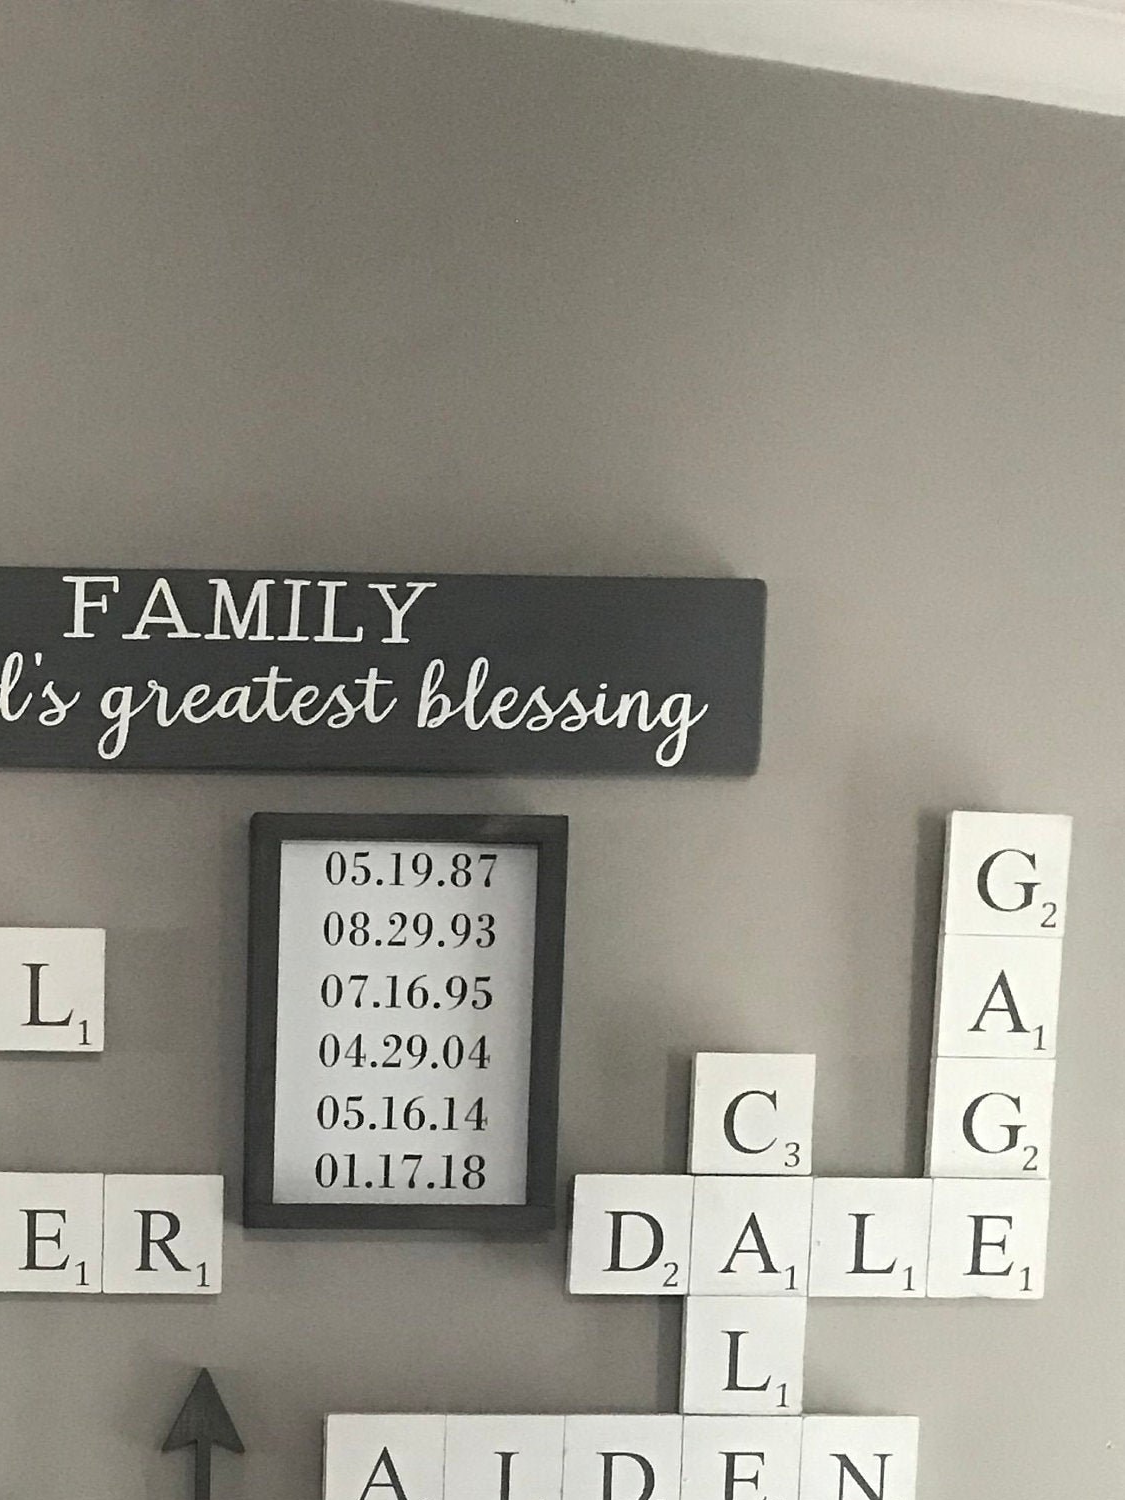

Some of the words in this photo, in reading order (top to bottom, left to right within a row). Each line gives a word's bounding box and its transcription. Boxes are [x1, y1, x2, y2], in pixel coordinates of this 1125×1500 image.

[62, 575, 437, 644] FAMILY
[98, 665, 397, 760] greatest
[417, 657, 708, 768] blessing
[325, 851, 498, 888] 05.19.87
[323, 911, 497, 949] 08.29.93
[1040, 901, 1057, 929] 2
[321, 973, 493, 1011] 07.16.95
[78, 1019, 92, 1046] 1
[1033, 1024, 1047, 1051] 1
[318, 1033, 491, 1069] 04.29.04
[962, 848, 1042, 1277] GAGE
[316, 1095, 488, 1132] 05.16.14
[315, 1153, 486, 1190] 01.17.18
[784, 1141, 801, 1168] 3
[1022, 1145, 1038, 1172] 2
[602, 1210, 1015, 1277] DALE
[74, 1260, 90, 1287] 1
[196, 1261, 211, 1288] 1
[662, 1261, 679, 1288] 2
[784, 1264, 798, 1291] 1
[903, 1265, 915, 1292] 1
[1020, 1266, 1032, 1292] 1
[776, 1382, 790, 1408] 1
